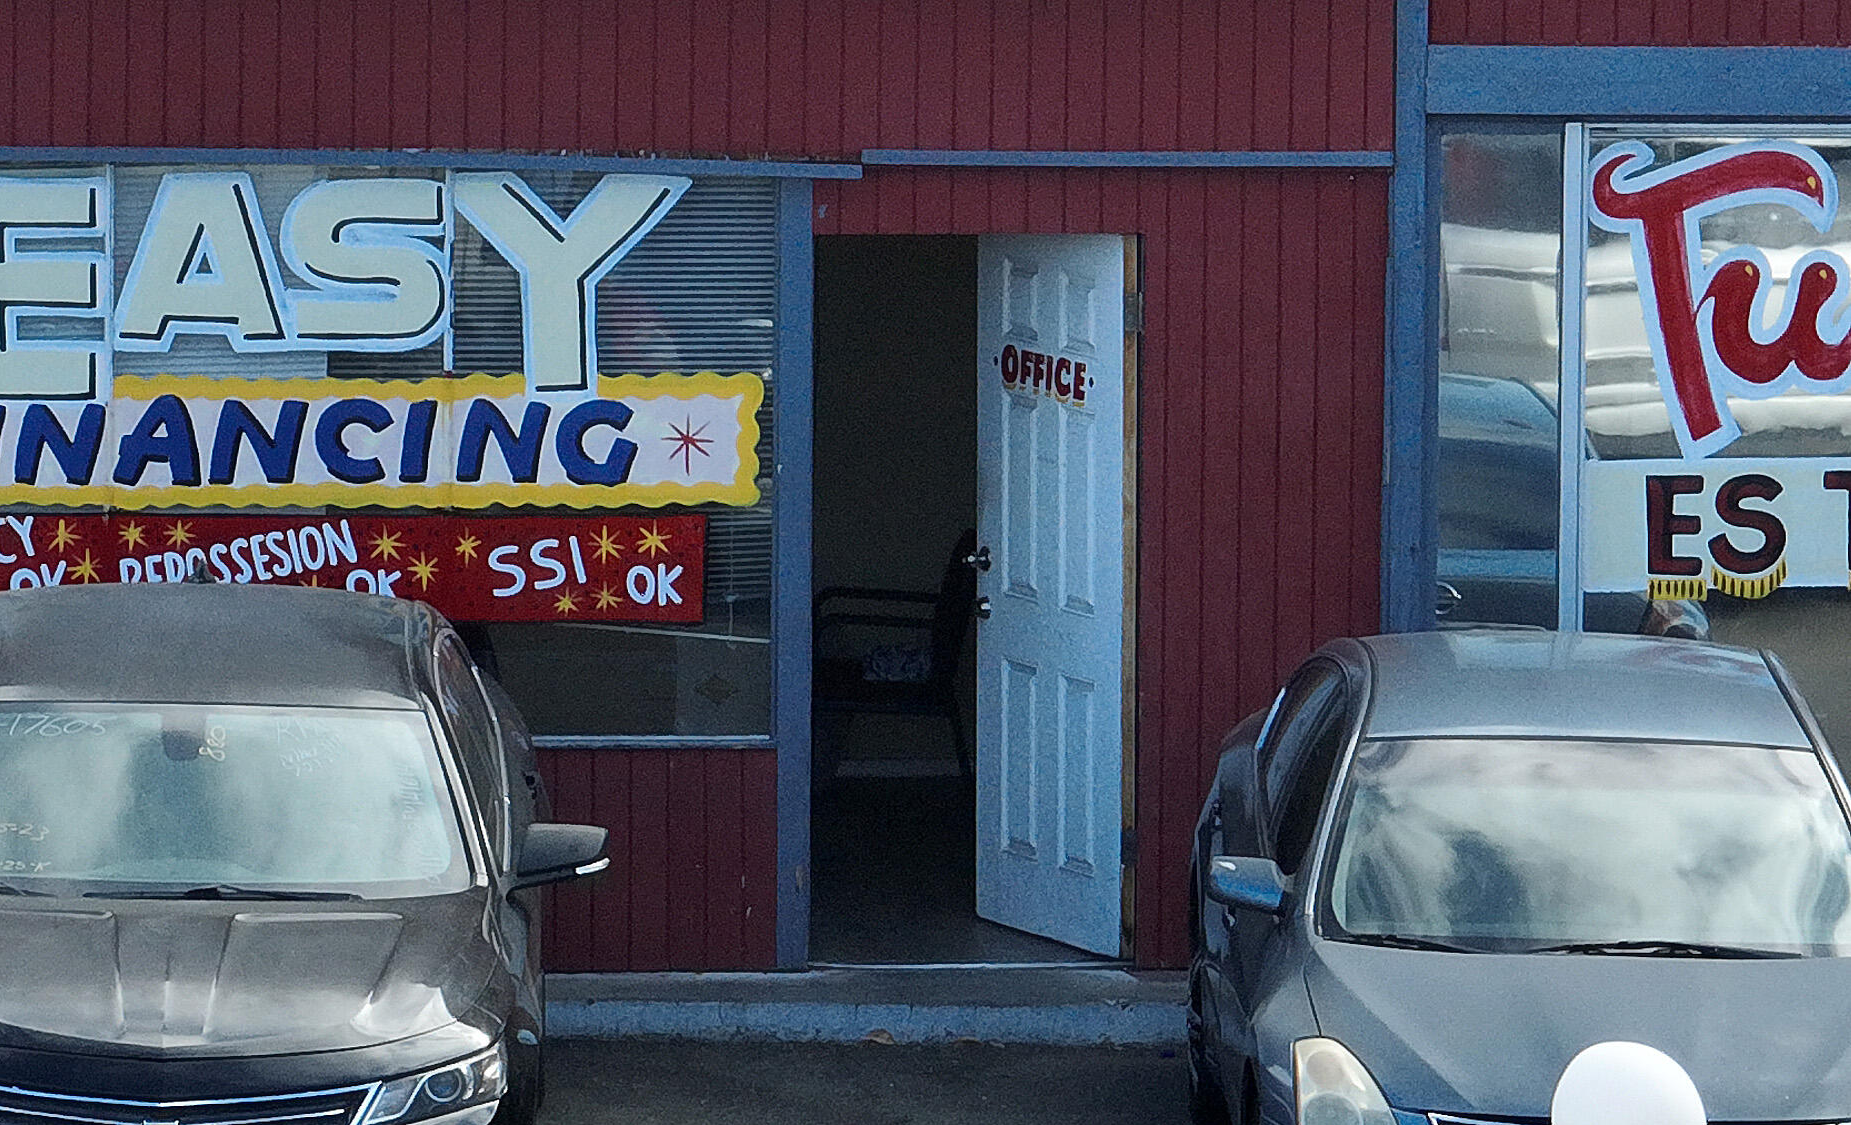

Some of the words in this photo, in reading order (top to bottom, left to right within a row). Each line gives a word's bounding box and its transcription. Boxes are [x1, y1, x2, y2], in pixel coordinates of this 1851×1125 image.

[1000, 344, 1087, 401] OFFICE
[1646, 473, 1788, 577] ES
[345, 568, 402, 598] OK
[487, 535, 587, 597] SSI
[626, 563, 684, 607] OK
